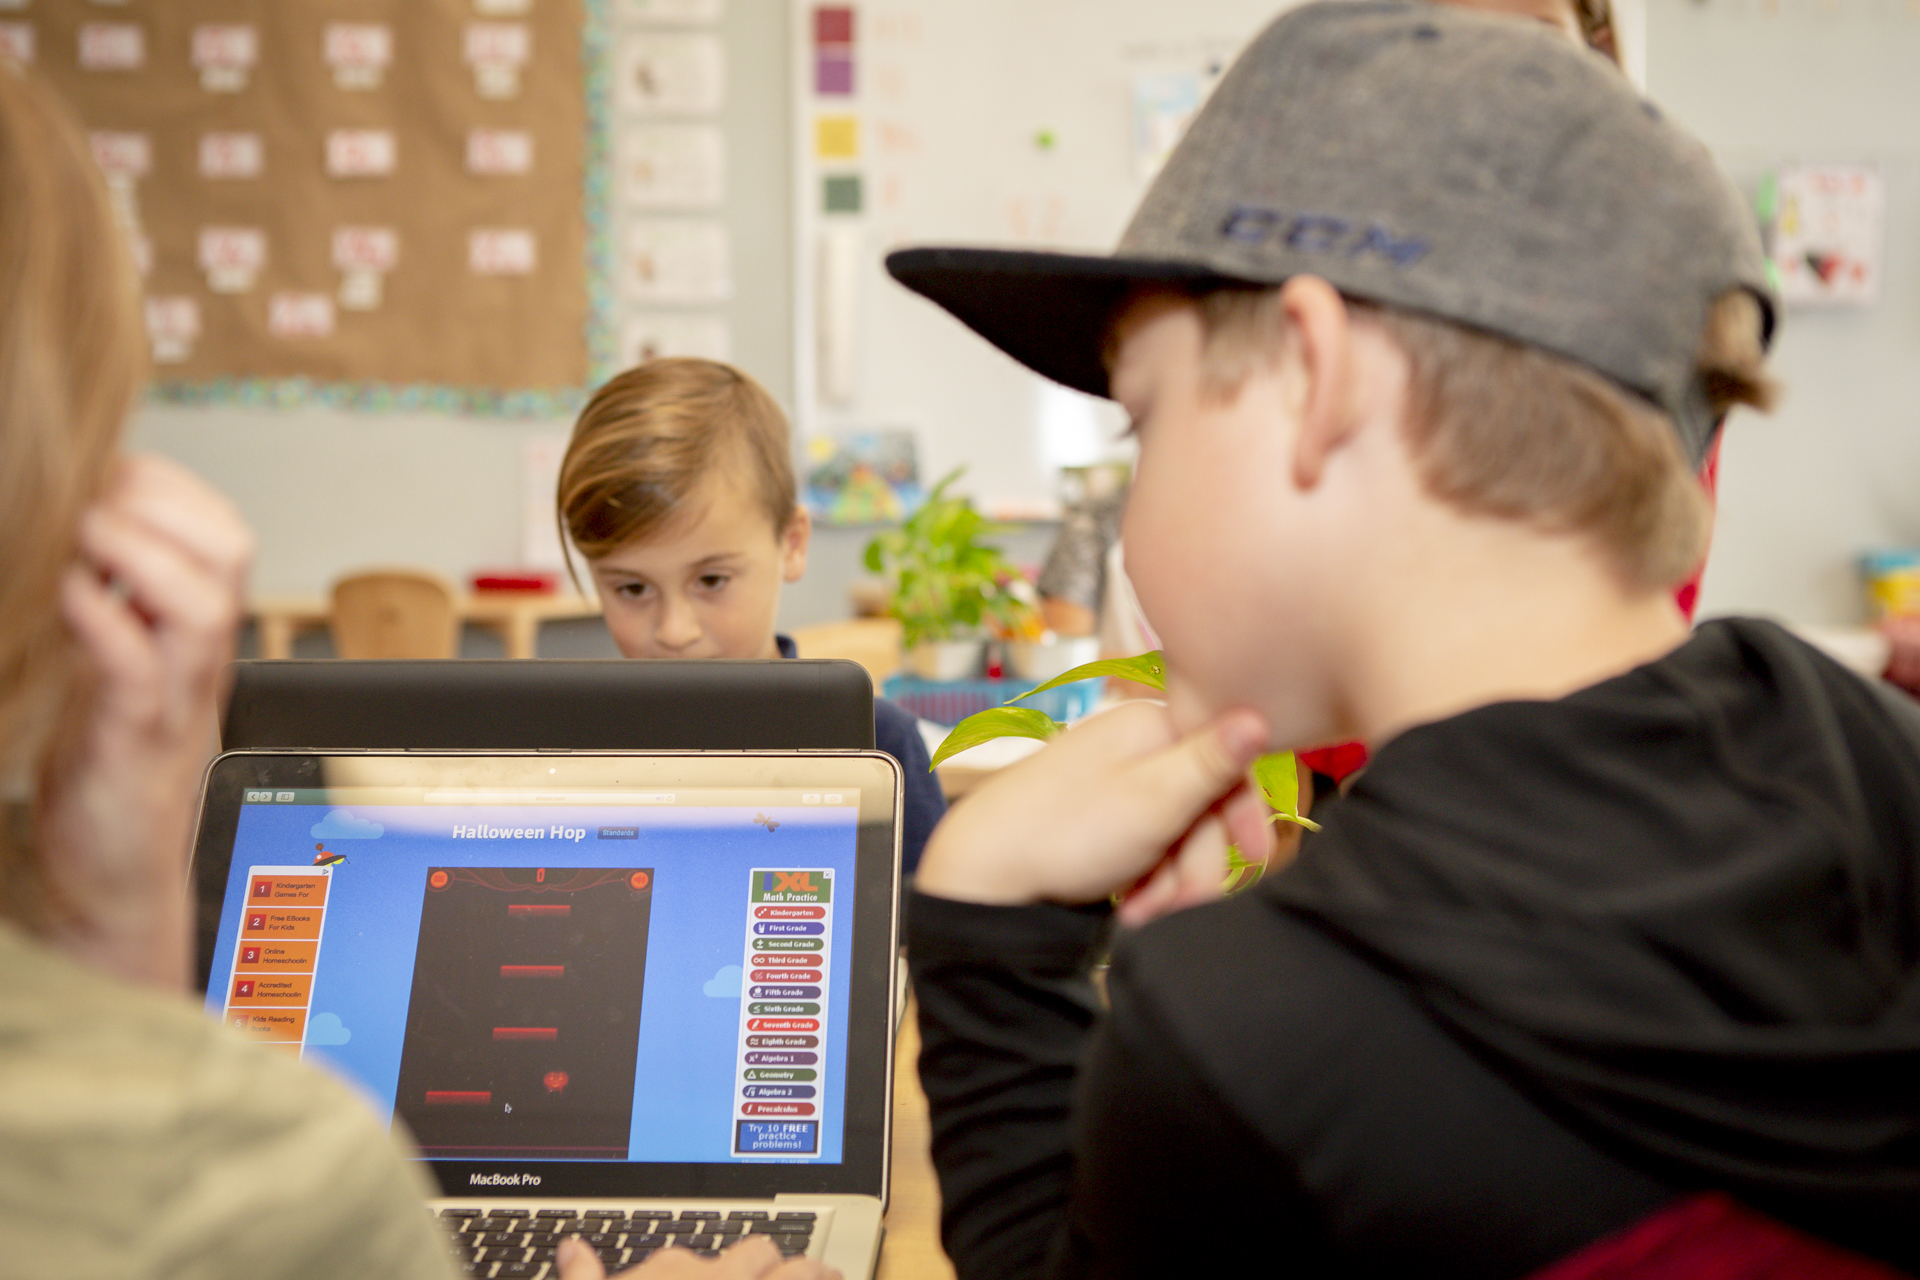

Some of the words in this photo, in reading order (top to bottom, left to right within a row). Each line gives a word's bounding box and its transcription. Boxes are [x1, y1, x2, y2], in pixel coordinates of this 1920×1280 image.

[452, 824, 545, 839] Halloween
[550, 825, 586, 843] Hop
[602, 829, 634, 837] Standards
[763, 872, 818, 892] IXL
[260, 885, 265, 893] 1
[763, 892, 784, 902] Math
[787, 892, 818, 902] Practice
[253, 918, 260, 926] 2
[247, 951, 254, 960] 3
[766, 972, 789, 980] Fourth
[790, 972, 811, 980] Grade
[241, 984, 248, 993] 4
[764, 1005, 782, 1013] Sixth
[783, 1005, 804, 1013] Grade
[235, 1019, 242, 1028] 5
[268, 1016, 295, 1024] Reading
[763, 1021, 791, 1029] Seventh
[792, 1021, 813, 1029] Grade
[762, 1038, 784, 1046] Eighth
[761, 1055, 789, 1063] Algebra
[759, 1071, 794, 1079] Geometry
[758, 1088, 786, 1097] Algebra
[787, 1088, 793, 1096] 2
[757, 1105, 798, 1113] Precalculus
[748, 1124, 763, 1134] Try
[768, 1124, 779, 1132] 10
[782, 1124, 809, 1133] FREE
[758, 1132, 797, 1141] practice
[752, 1140, 802, 1150] problems!
[469, 1173, 521, 1186] MacBook
[522, 1173, 541, 1186] Pro
